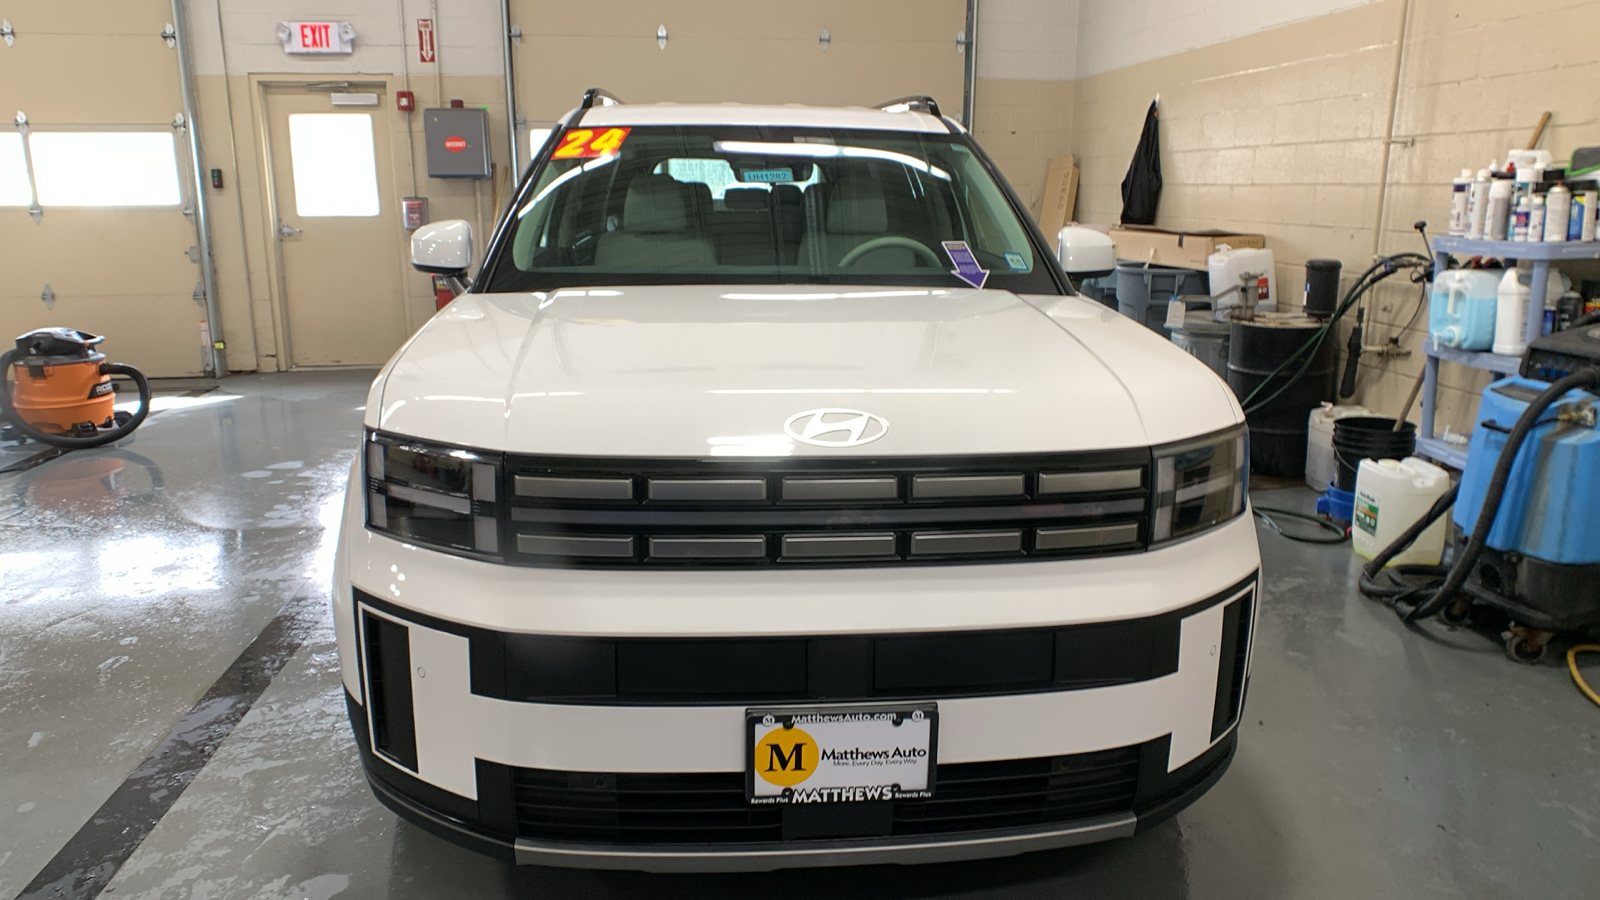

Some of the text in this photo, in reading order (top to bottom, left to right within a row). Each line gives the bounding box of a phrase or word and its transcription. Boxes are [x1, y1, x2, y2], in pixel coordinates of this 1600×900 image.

[299, 24, 331, 49] EXIT
[554, 128, 626, 158] 24
[791, 712, 897, 724] MatthewsAuto.com
[763, 742, 808, 773] M
[821, 746, 927, 761] Matthews Auto
[852, 760, 870, 768] Every
[792, 785, 893, 804] MATTHEWS
[894, 791, 919, 799] Rewards
